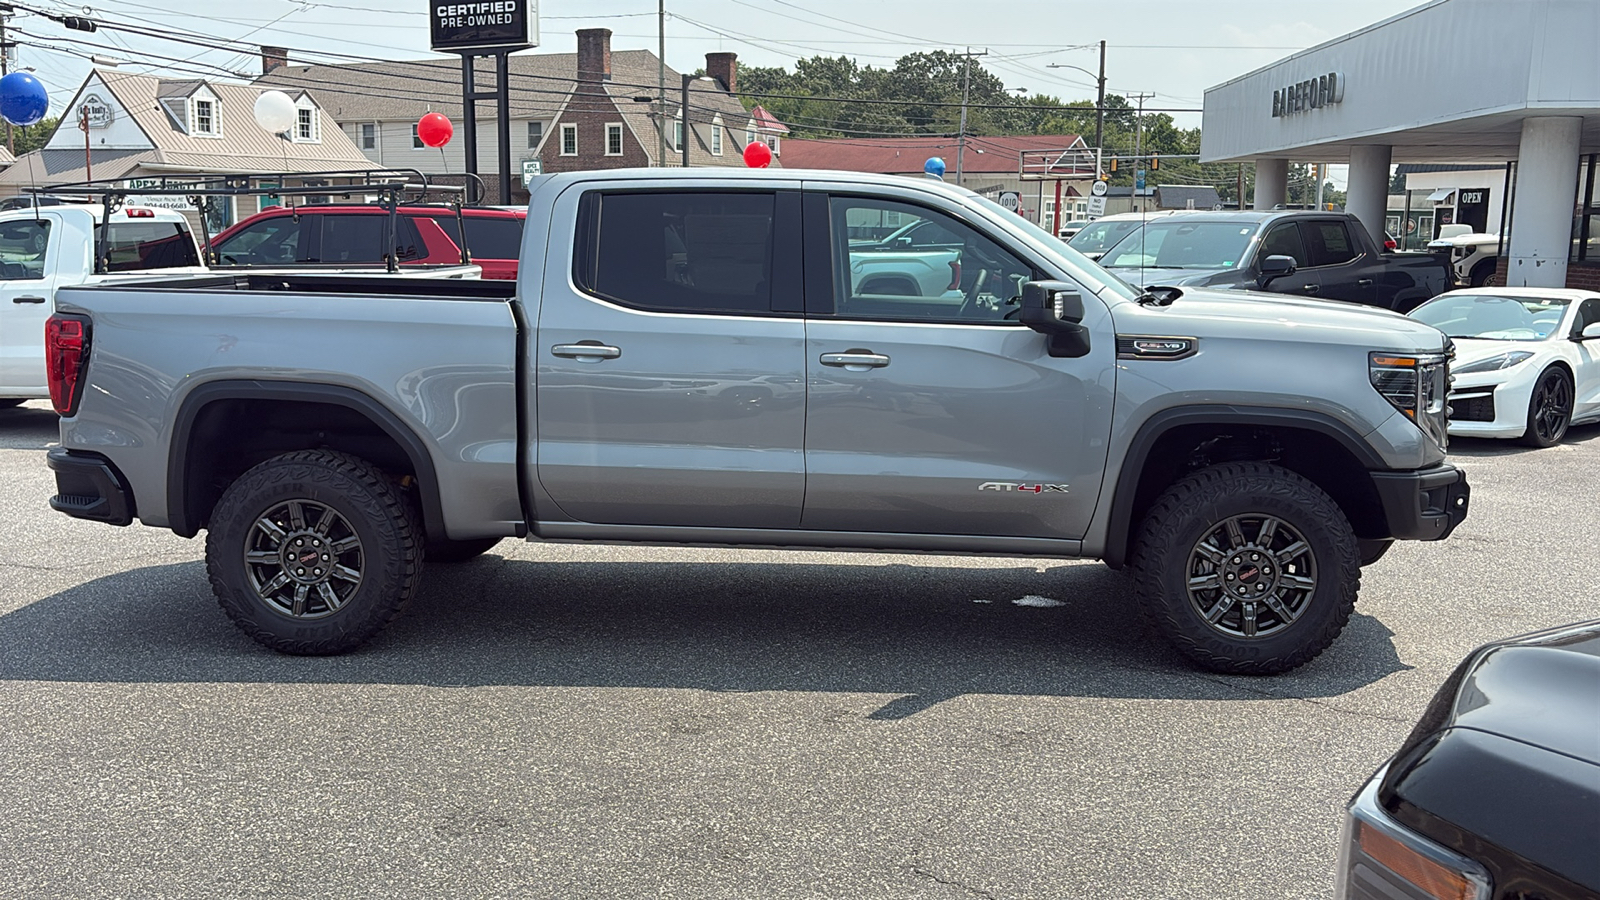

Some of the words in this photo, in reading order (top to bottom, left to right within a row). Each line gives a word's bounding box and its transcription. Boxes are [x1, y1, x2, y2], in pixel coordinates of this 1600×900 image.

[437, 1, 516, 17] CERTIFIED
[441, 13, 512, 28] PRE-OWNED
[1272, 72, 1345, 117] BAREFORD
[129, 180, 157, 189] APEX
[1001, 198, 1017, 207] 1010
[1462, 192, 1482, 203] OPEN
[978, 481, 1070, 495] AT4X
